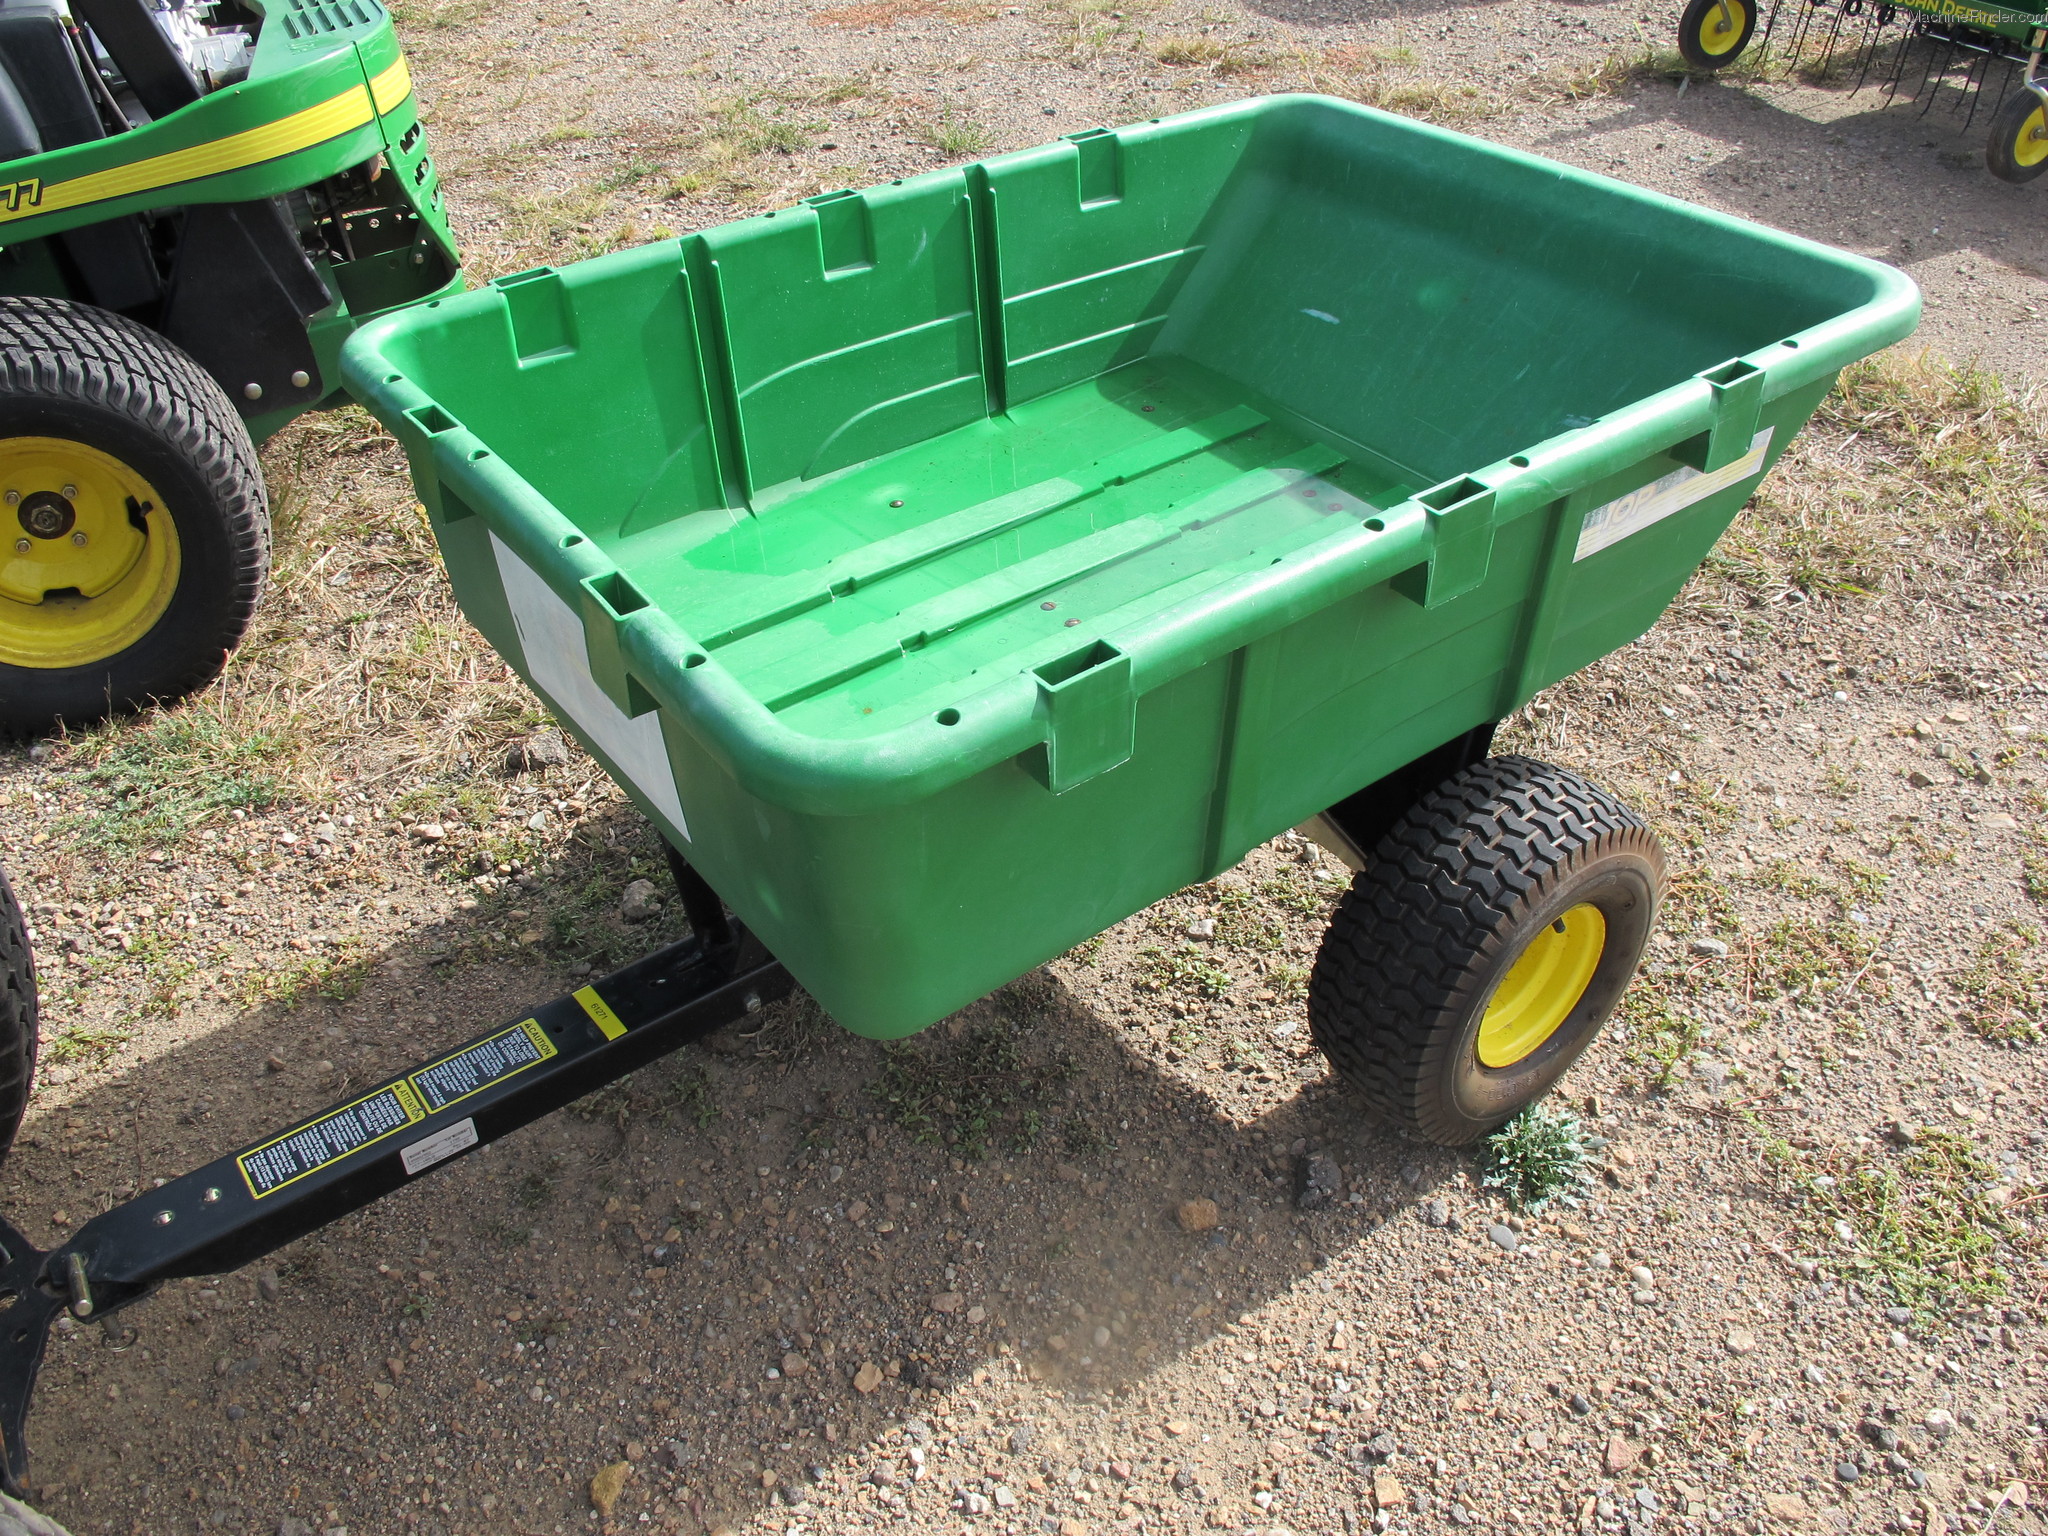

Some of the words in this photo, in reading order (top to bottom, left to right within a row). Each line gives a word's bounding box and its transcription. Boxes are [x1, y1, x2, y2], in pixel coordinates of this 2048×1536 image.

[1895, 0, 1940, 12] OHN
[590, 1002, 608, 1020] 61271
[526, 1026, 553, 1055] CAUTION
[398, 1088, 422, 1119] ATTENTION
